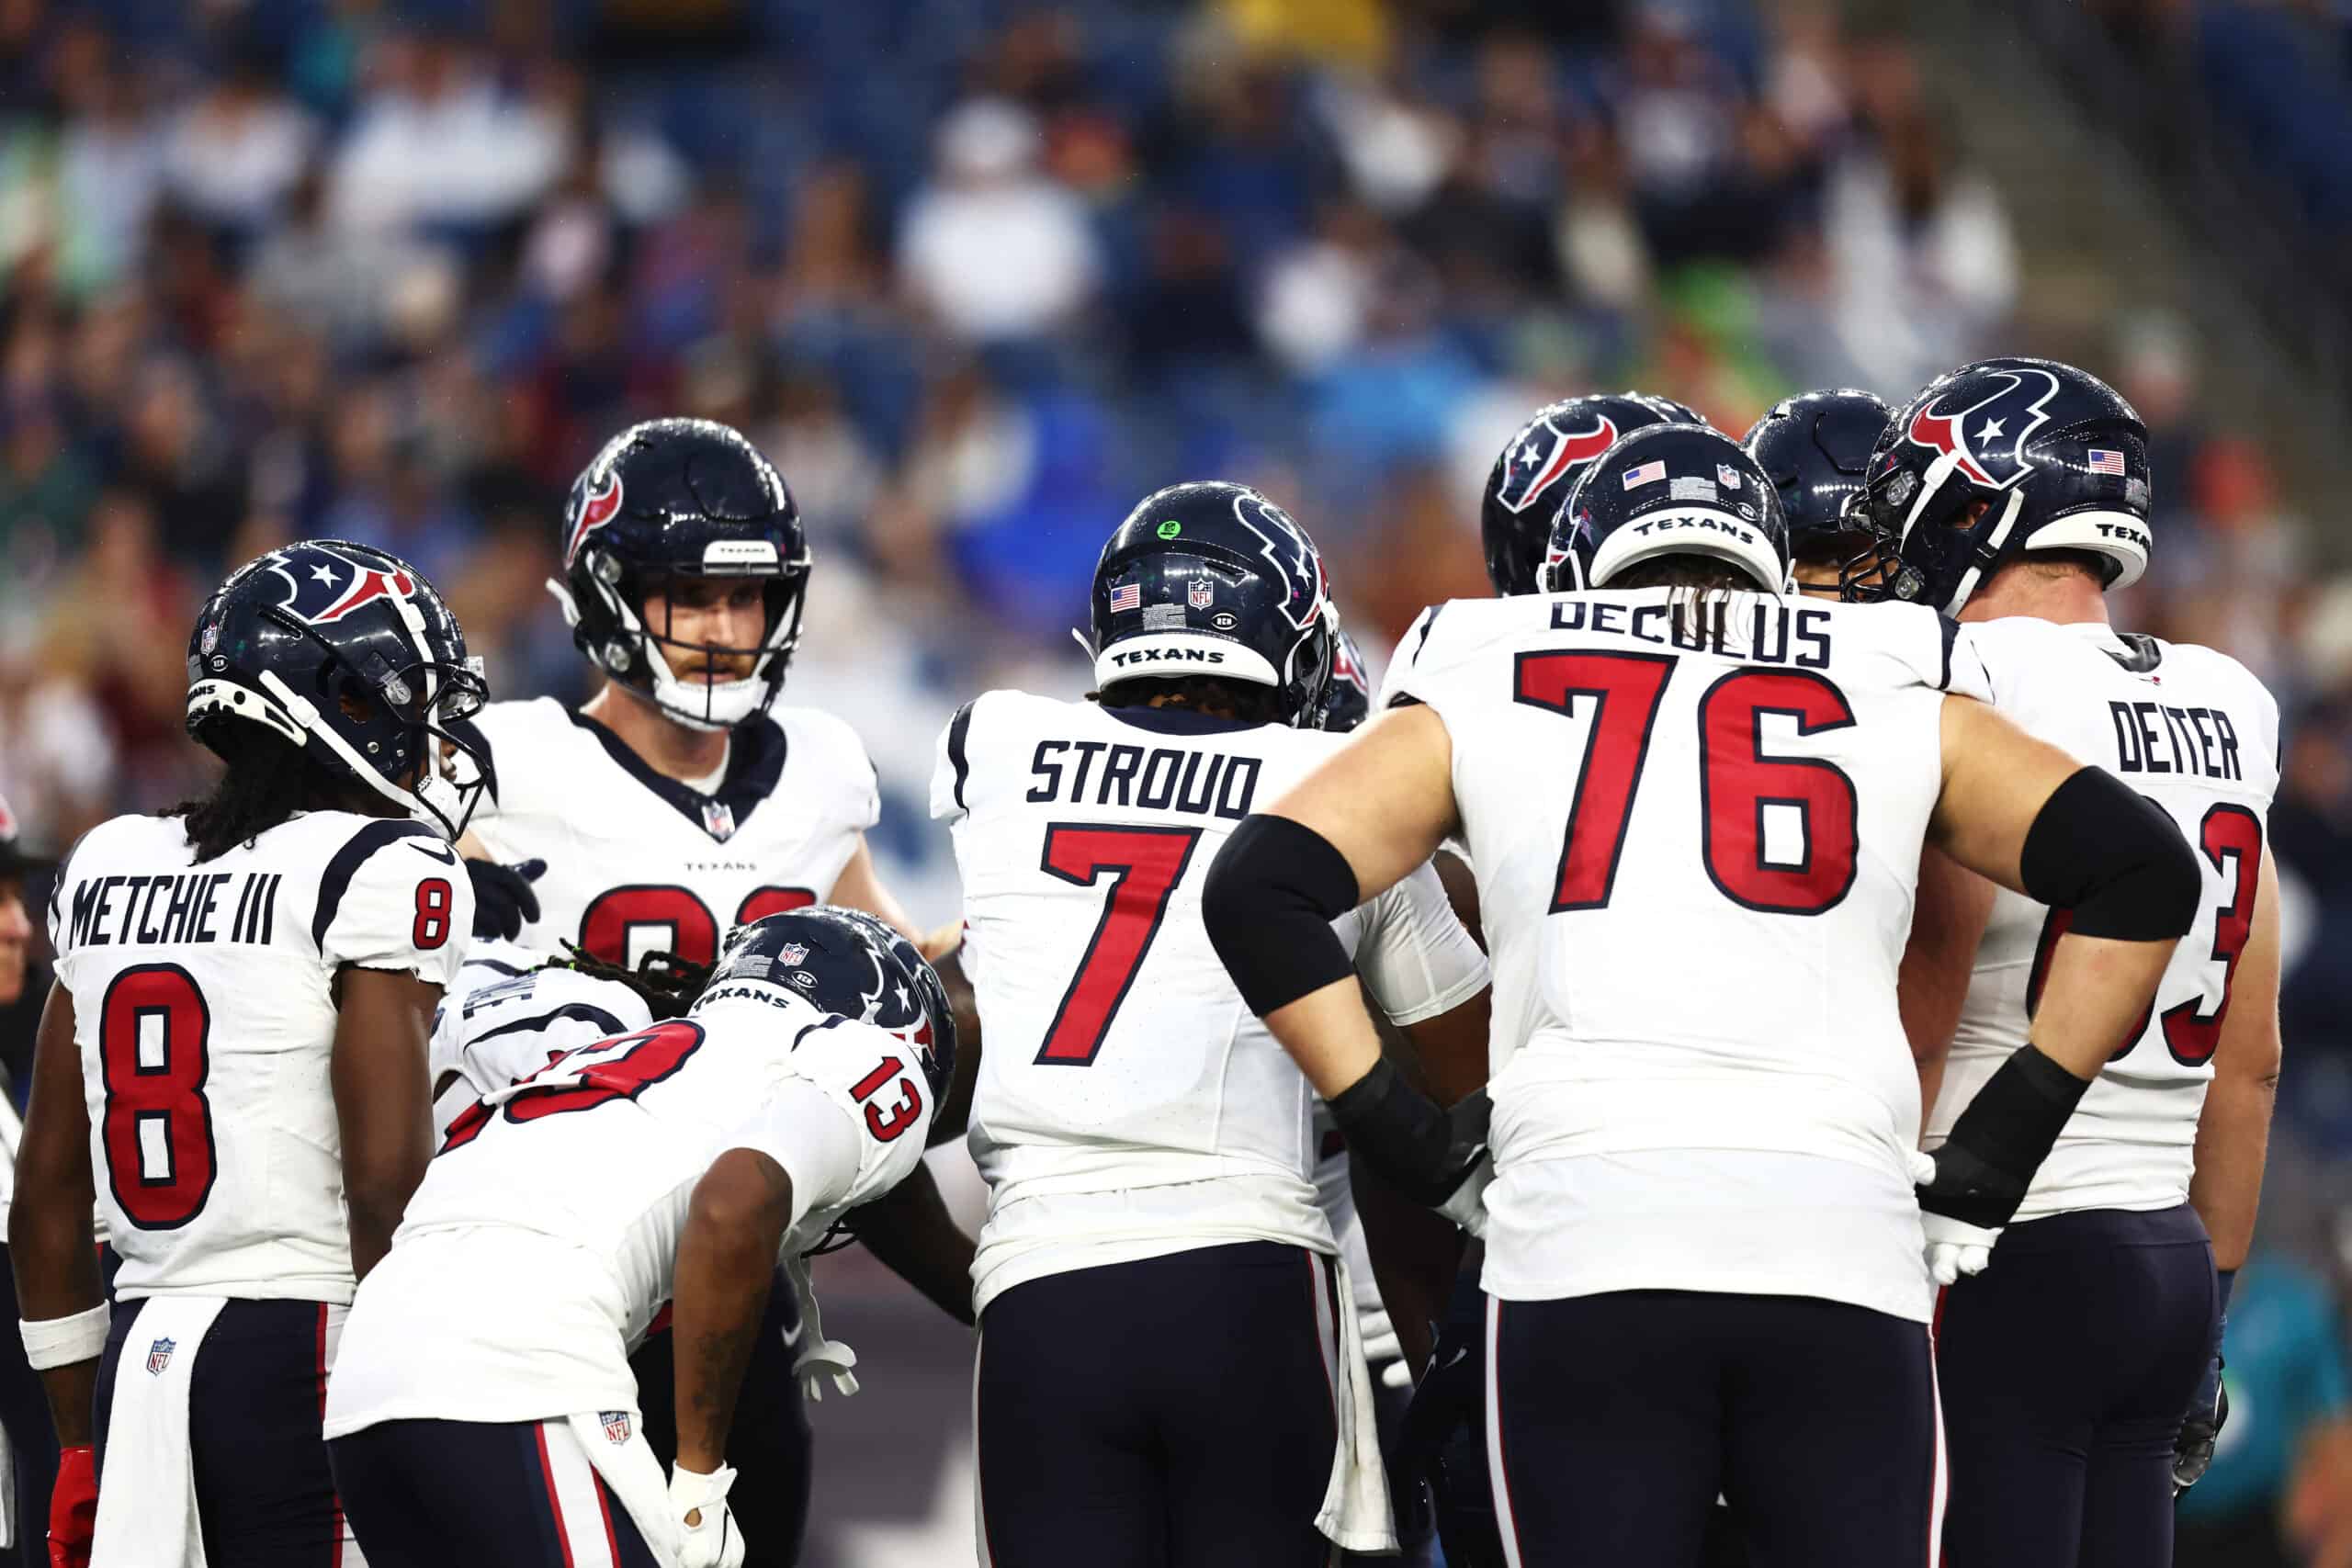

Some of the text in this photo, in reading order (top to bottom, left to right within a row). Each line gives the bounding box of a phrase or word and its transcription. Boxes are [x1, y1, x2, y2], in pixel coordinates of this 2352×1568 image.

[1633, 516, 1754, 545] TEXANS
[1192, 592, 1210, 604] NFL
[1112, 648, 1225, 668] TEXANS
[1550, 601, 1831, 669] DECULUS
[2109, 701, 2243, 781] DEITER
[1026, 739, 1263, 820] STROUD
[1513, 648, 1859, 916] 76
[684, 862, 757, 872] TEXANS
[69, 874, 282, 950] METCHIE III
[413, 878, 453, 950] 8
[1033, 821, 1204, 1066] 7
[783, 950, 802, 963] NFL
[694, 987, 790, 1012] TEXANS
[98, 963, 218, 1231] 8
[850, 1055, 923, 1143] 13
[150, 1353, 169, 1371] NFL
[605, 1421, 630, 1442] NFL
